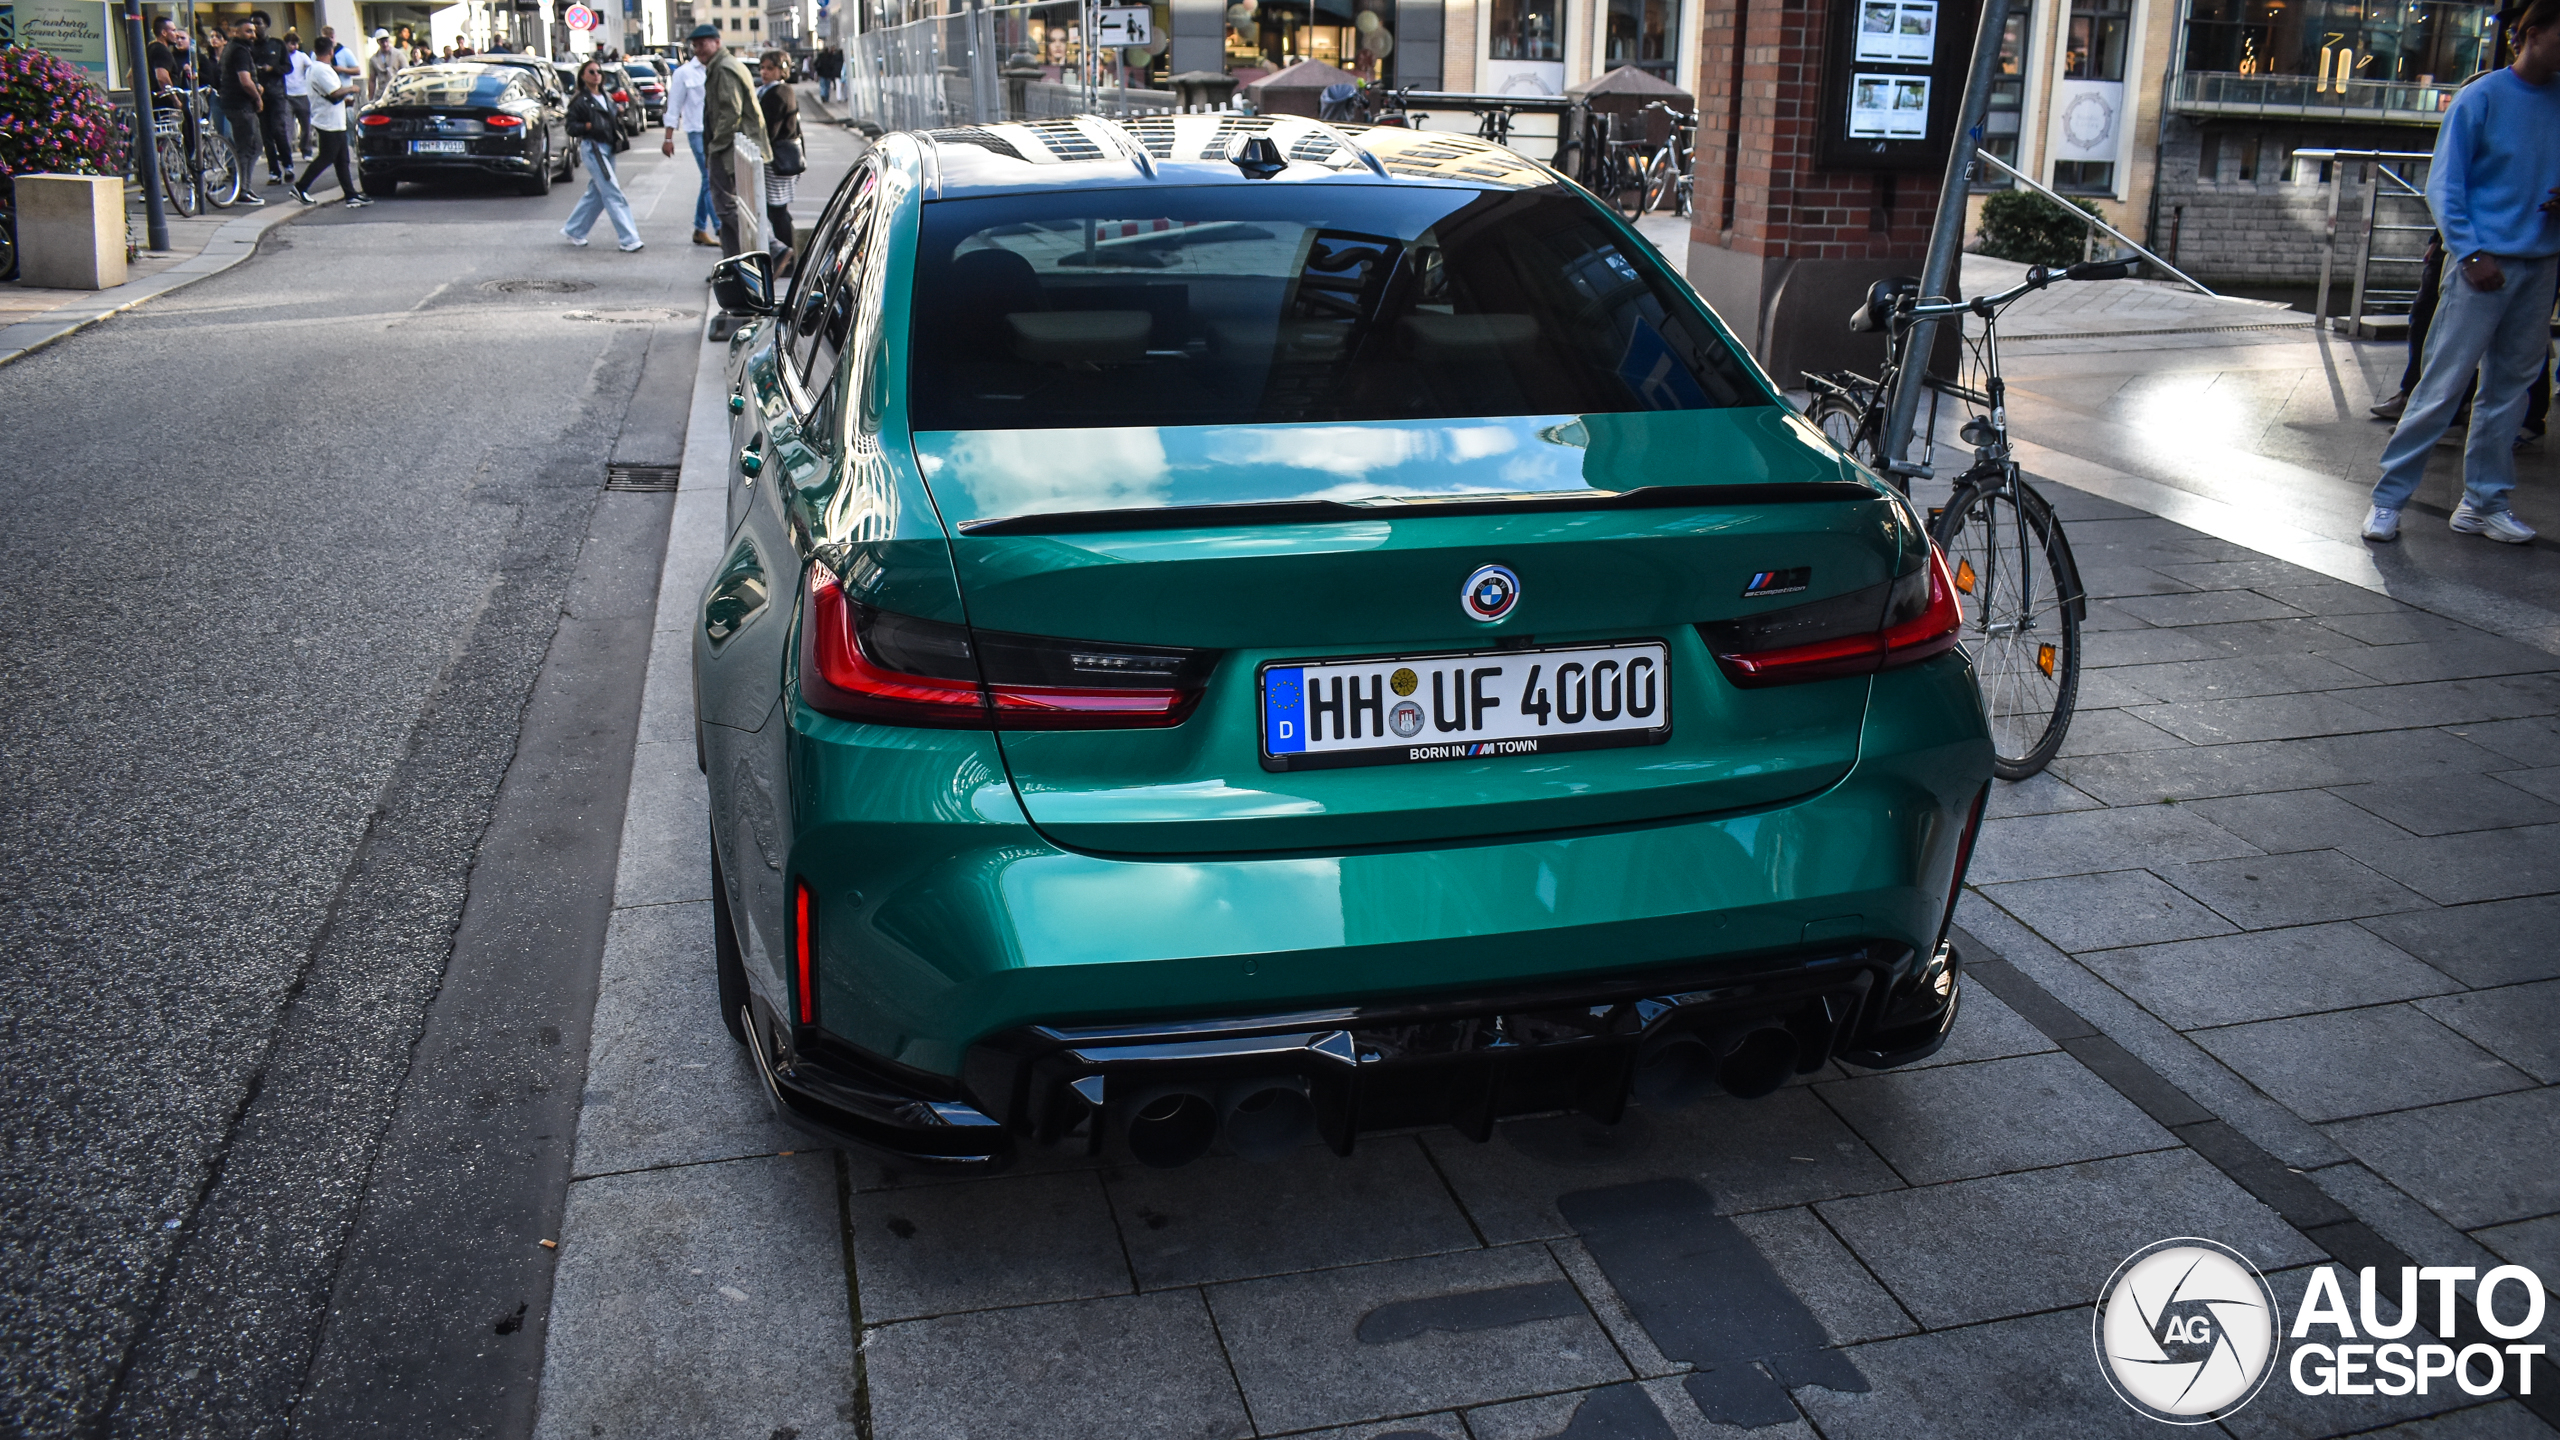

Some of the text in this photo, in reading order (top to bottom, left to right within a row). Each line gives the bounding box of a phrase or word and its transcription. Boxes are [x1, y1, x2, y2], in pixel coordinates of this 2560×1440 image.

[1477, 577, 1508, 590] BMW
[1751, 585, 1807, 597] competition
[1308, 674, 1385, 742] HH
[1432, 667, 1503, 733] UF
[1521, 656, 1657, 726] 4000
[1279, 720, 1294, 739] D
[1410, 746, 1450, 760] BORN
[1451, 745, 1466, 757] IN
[1496, 740, 1538, 754] TOWN
